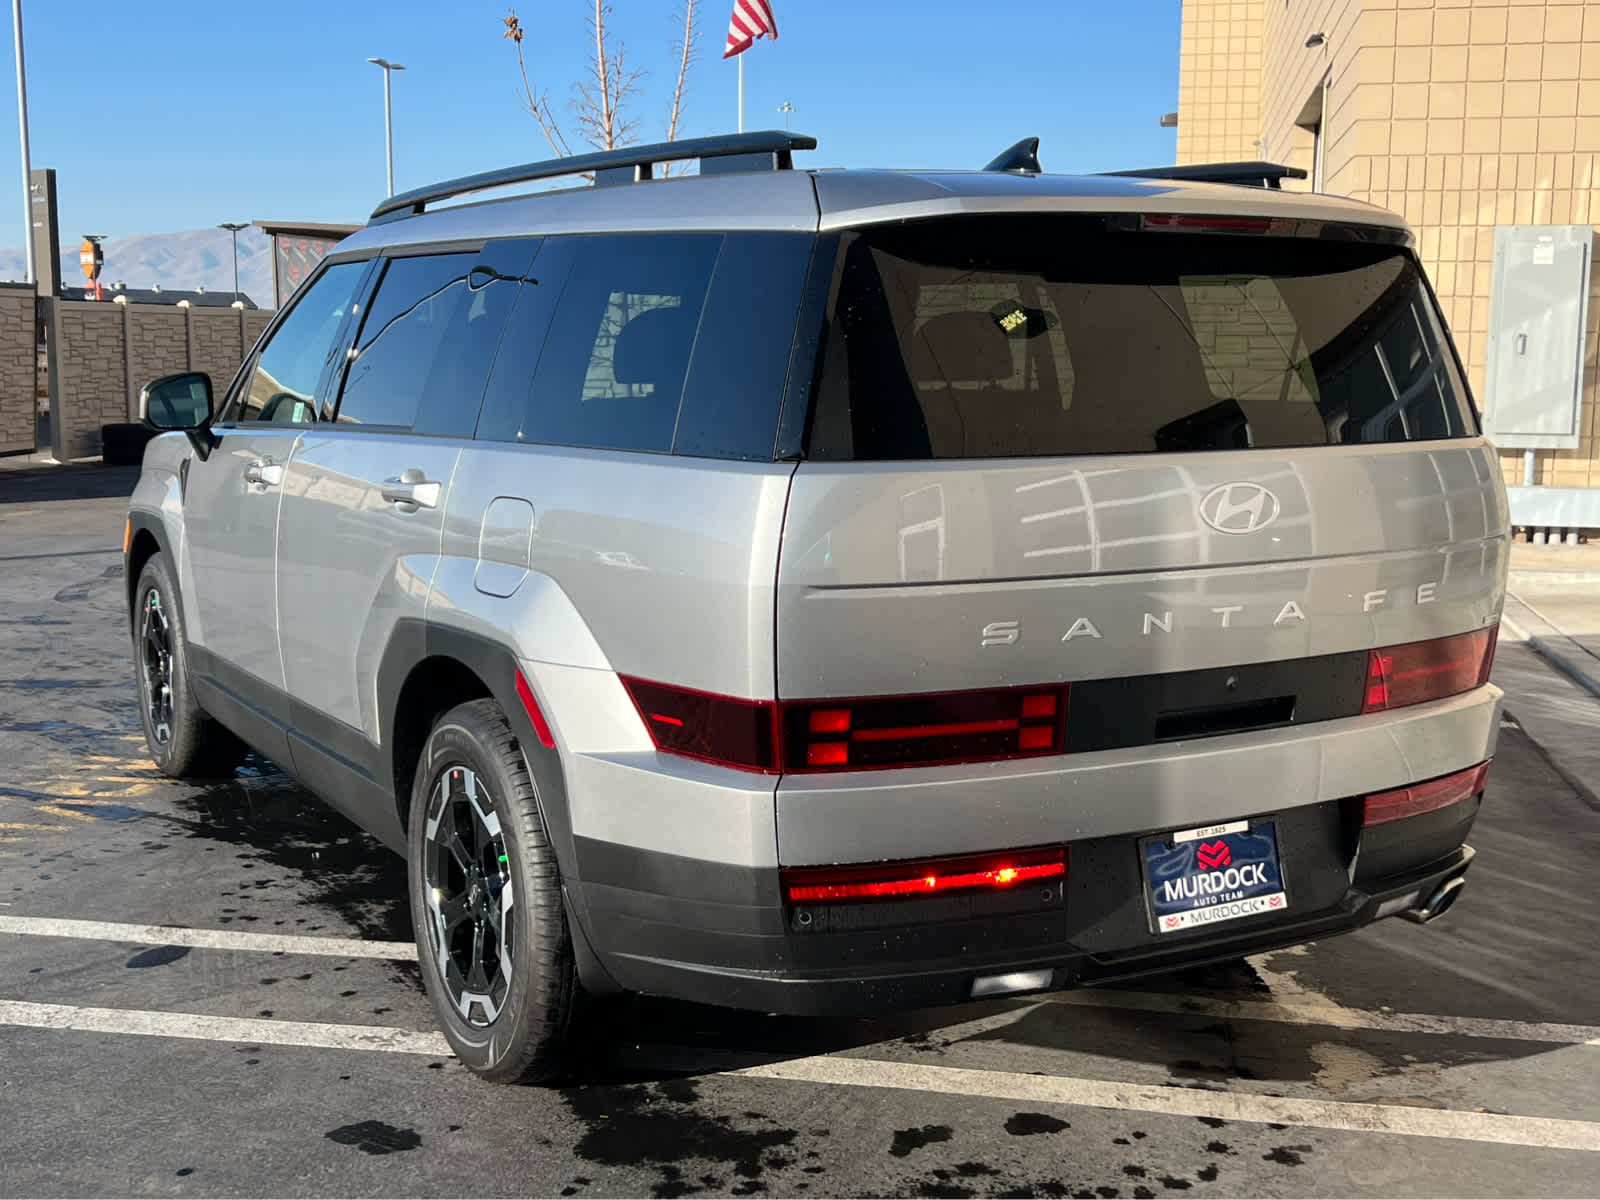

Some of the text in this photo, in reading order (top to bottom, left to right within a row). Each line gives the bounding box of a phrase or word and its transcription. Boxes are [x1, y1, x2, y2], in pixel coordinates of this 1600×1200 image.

[981, 582, 1438, 648] SANTA FE
[1164, 863, 1267, 901] MURDOCK
[1190, 900, 1259, 924] MURDOCK
[1193, 890, 1244, 906] AUTO TEAM
